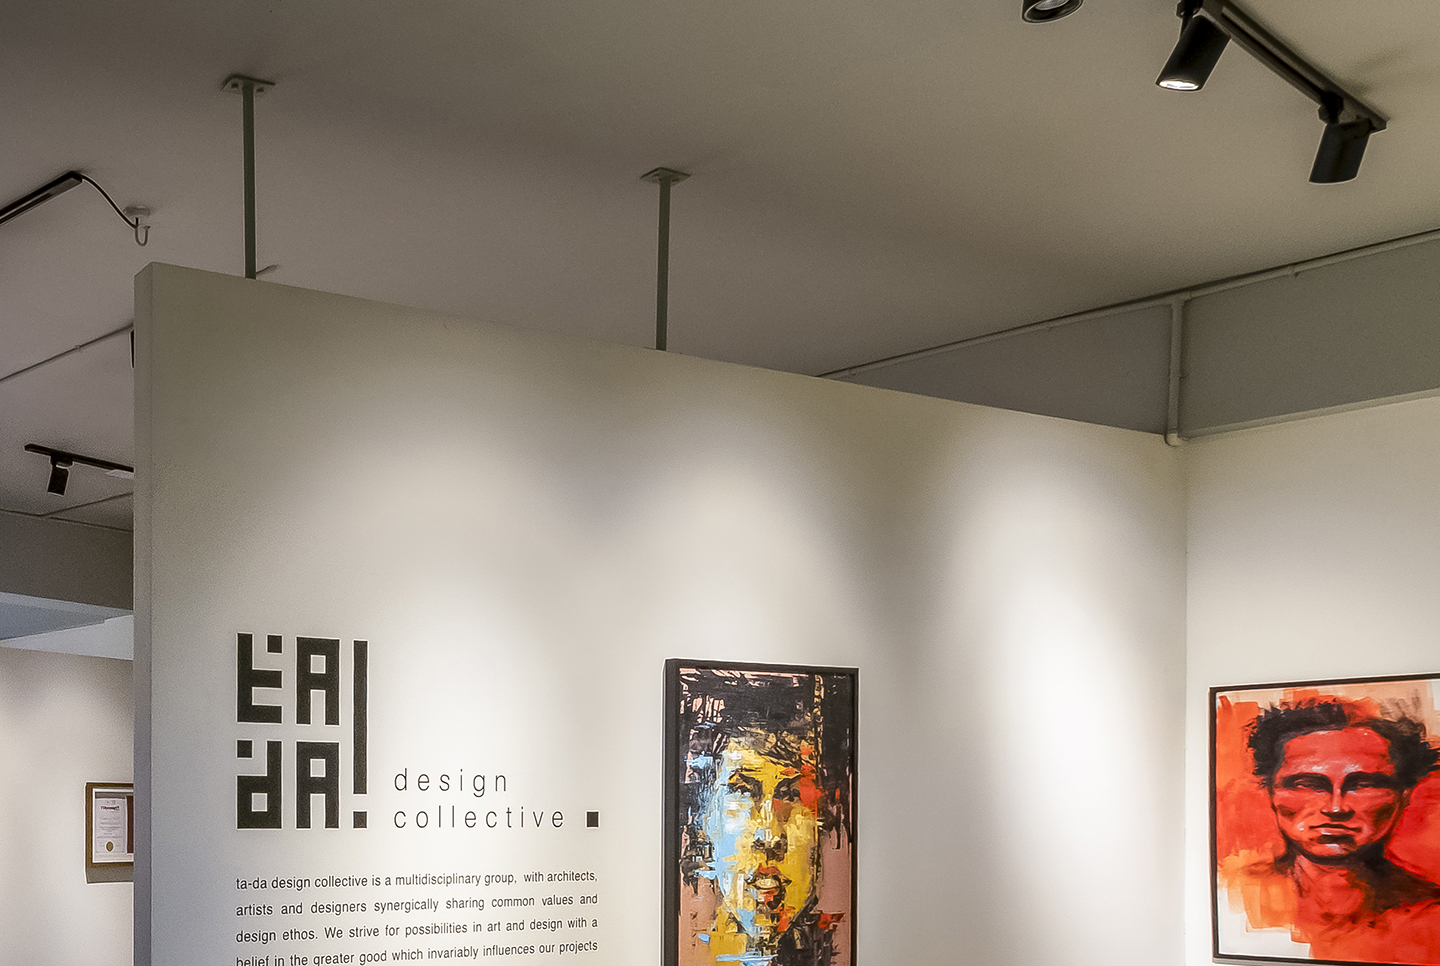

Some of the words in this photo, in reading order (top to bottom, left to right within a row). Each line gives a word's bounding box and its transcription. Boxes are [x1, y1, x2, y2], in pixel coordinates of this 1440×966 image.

[394, 768, 507, 798] design
[393, 805, 565, 829] collective
[236, 877, 267, 890] ta-da
[271, 876, 310, 891] design
[314, 875, 368, 888] collective
[371, 873, 382, 887] is
[383, 875, 393, 887] a
[395, 873, 481, 887] multidisciplinary
[484, 874, 517, 887] group,
[523, 871, 544, 882] with
[547, 870, 597, 882] architects,
[236, 903, 273, 916] artists
[281, 902, 303, 915] and
[310, 901, 367, 916] designers
[374, 898, 439, 914] synergically
[446, 897, 485, 911] sharing
[491, 897, 535, 908] common
[541, 894, 573, 906] values
[580, 894, 598, 904] and
[236, 930, 276, 945] design
[282, 928, 318, 941] ethos.
[323, 926, 344, 940] We
[349, 925, 379, 938] strive
[385, 924, 400, 936] for
[405, 922, 468, 938] possibilities
[472, 920, 483, 933] in
[487, 921, 501, 932] art
[506, 919, 525, 931] and
[530, 918, 563, 932] design
[567, 917, 587, 928] with
[591, 918, 599, 929] a
[290, 954, 308, 966] the
[359, 950, 387, 966] good
[391, 948, 423, 961] which
[428, 946, 479, 960] invariably
[483, 944, 535, 956] influences
[539, 944, 555, 954] our
[559, 940, 598, 955] projects
